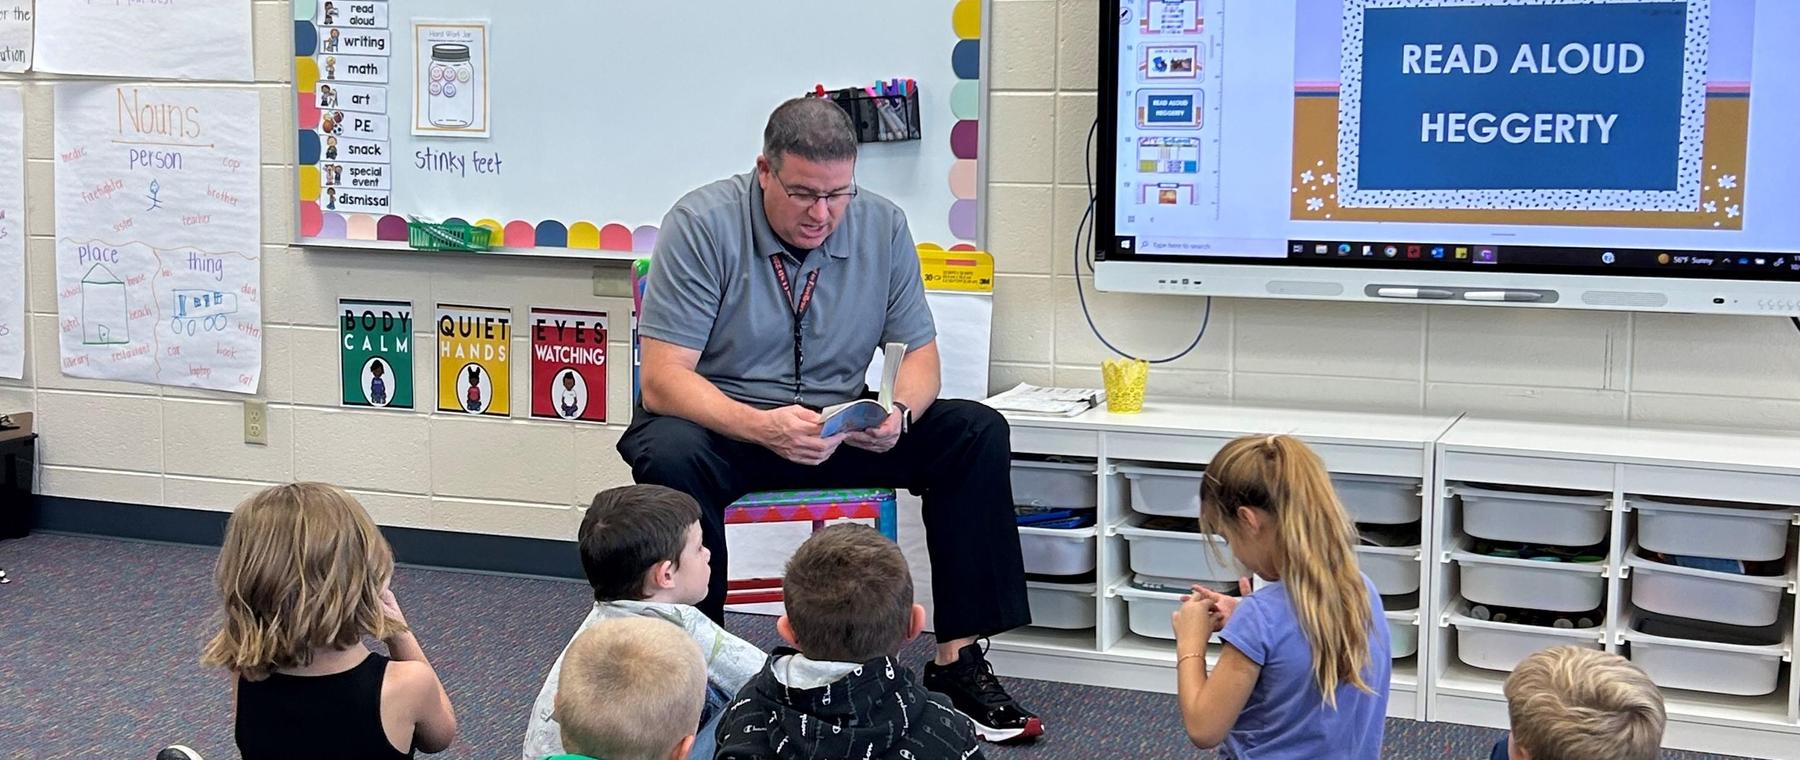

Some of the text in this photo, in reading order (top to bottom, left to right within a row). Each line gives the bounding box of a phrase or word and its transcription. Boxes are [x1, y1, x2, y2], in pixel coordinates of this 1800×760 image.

[13, 6, 31, 21] the
[350, 4, 374, 13] read
[349, 16, 375, 26] aloud
[344, 36, 385, 50] writing
[1402, 42, 1645, 75] READ ALOUD
[347, 63, 378, 75] math
[351, 93, 370, 105] art
[116, 88, 200, 138] Nouns
[354, 119, 374, 132] P.E.
[1421, 113, 1618, 144] HEGGERTY
[129, 149, 182, 169] person
[348, 143, 382, 156] snack
[222, 157, 241, 173] cop
[472, 150, 503, 175] feet
[349, 167, 382, 179] special
[352, 178, 379, 187] event
[206, 185, 240, 206] brother
[338, 193, 389, 207] dismissal
[78, 244, 118, 265] place
[1691, 257, 1714, 265] Sunny
[187, 252, 224, 282] thing
[345, 309, 411, 333] BODY
[440, 315, 509, 340] QUIET
[536, 319, 605, 343] EYES
[344, 334, 408, 353] CALM
[441, 341, 506, 362] HANDS
[534, 344, 605, 366] WATCHING
